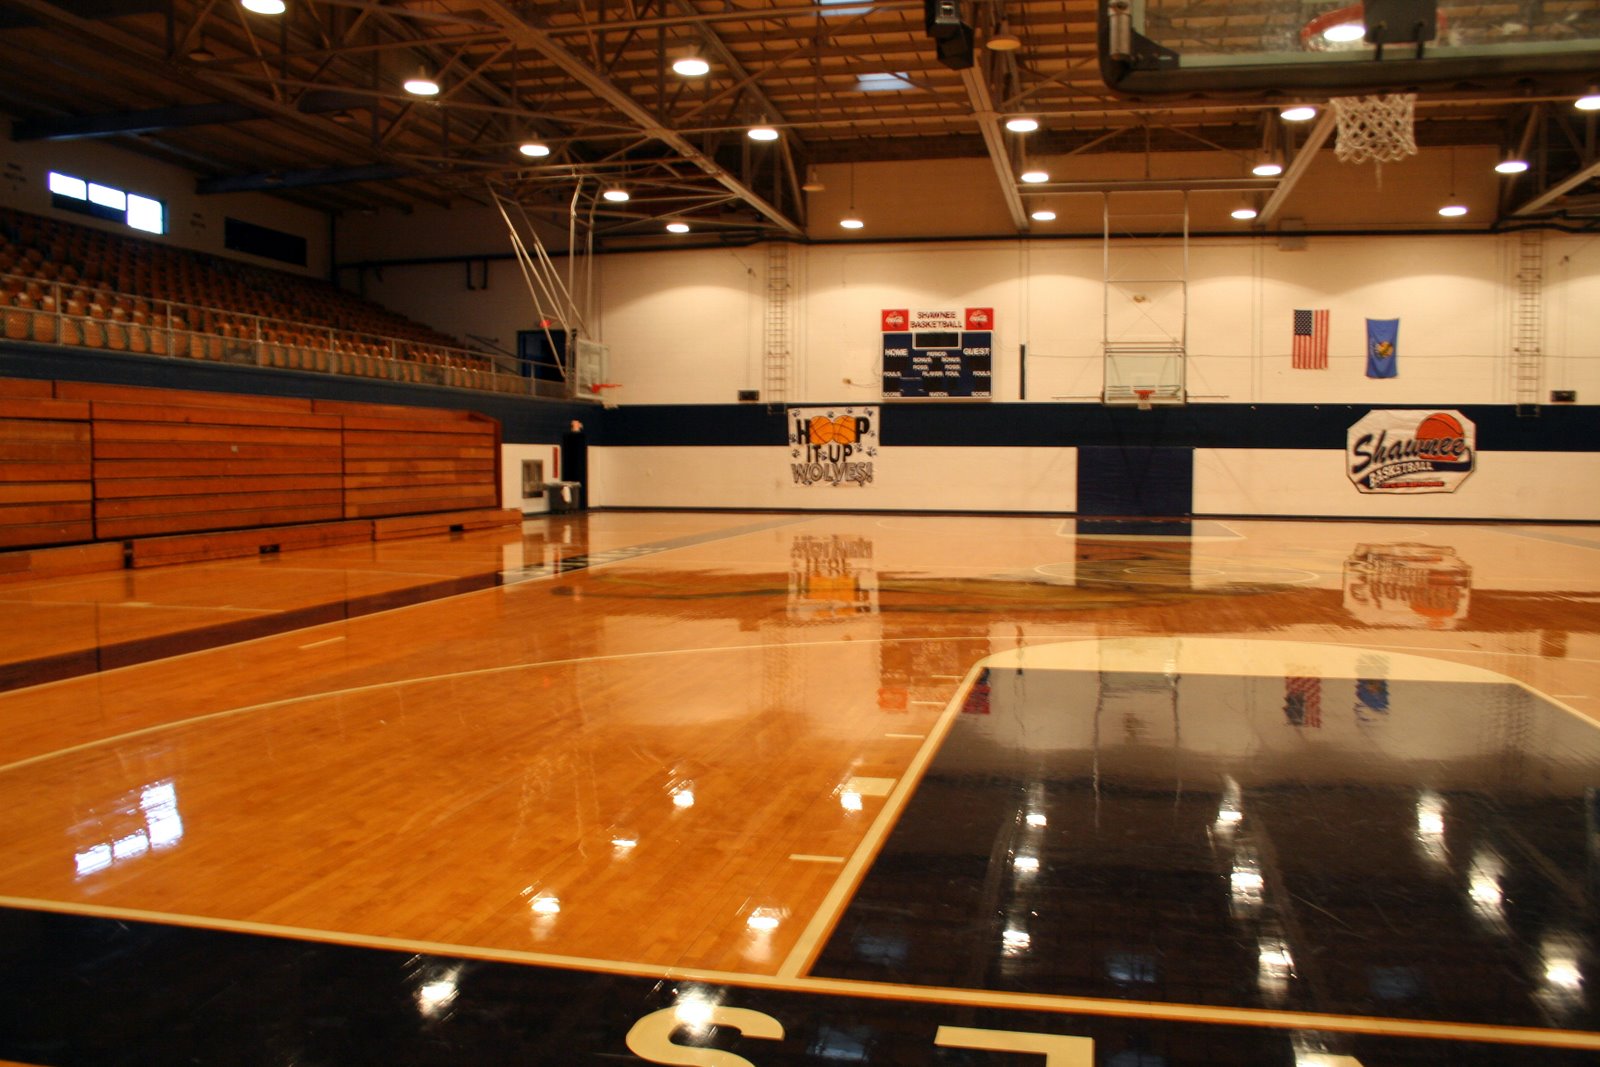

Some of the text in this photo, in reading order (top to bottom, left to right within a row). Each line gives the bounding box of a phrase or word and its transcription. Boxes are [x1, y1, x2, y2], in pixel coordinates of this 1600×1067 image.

[917, 311, 956, 319] SHAWNEE
[910, 320, 963, 328] BASKETBALL
[884, 348, 909, 357] HOME
[962, 347, 990, 356] GUEST
[806, 444, 853, 463] IT UP
[1352, 429, 1465, 473] Shawnee
